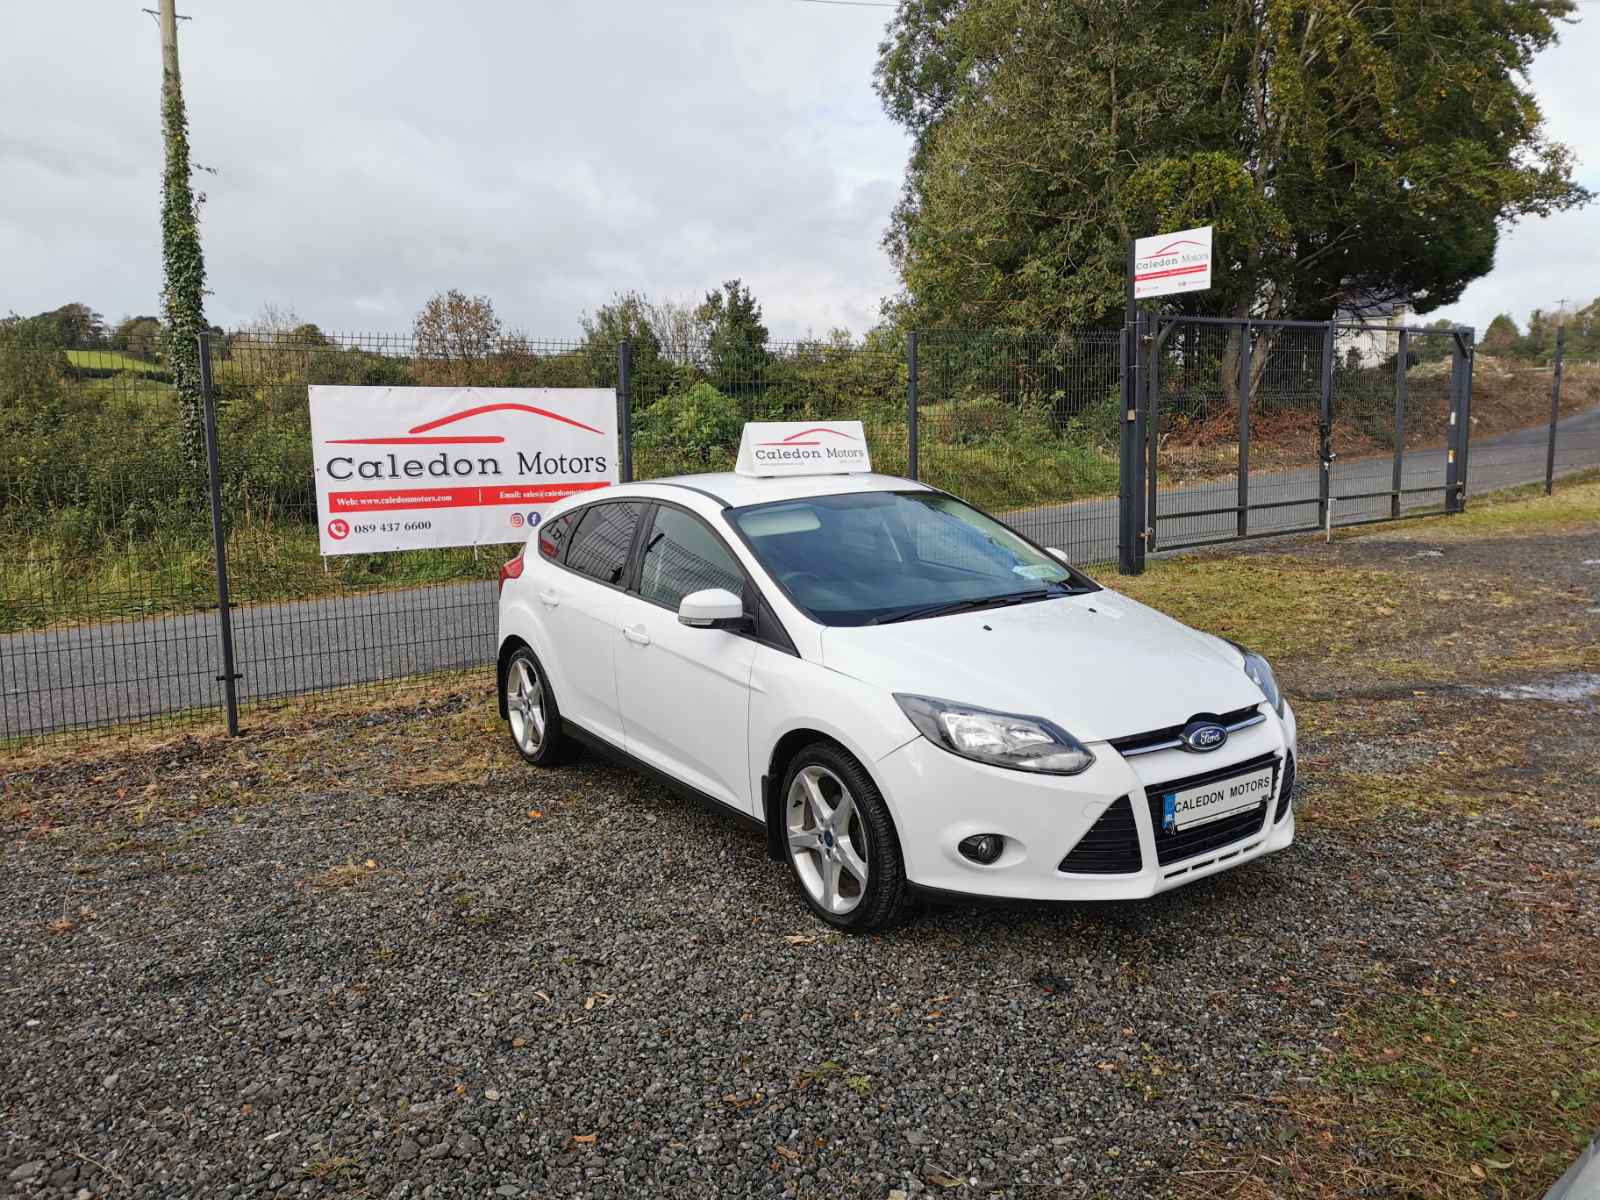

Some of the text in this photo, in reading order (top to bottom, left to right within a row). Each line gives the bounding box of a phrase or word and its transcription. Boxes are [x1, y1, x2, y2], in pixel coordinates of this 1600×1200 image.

[1136, 257, 1178, 270] Caledon
[755, 447, 864, 460] Caledon Motors
[326, 451, 607, 480] Caledon Motors
[336, 495, 453, 506] Web: www.caledonmotors.com
[499, 489, 521, 499] Email:
[354, 520, 432, 534] 089 437 6600
[1200, 729, 1221, 745] Ford
[1174, 790, 1225, 814] CALEDON
[1230, 776, 1270, 799] MOTORS
